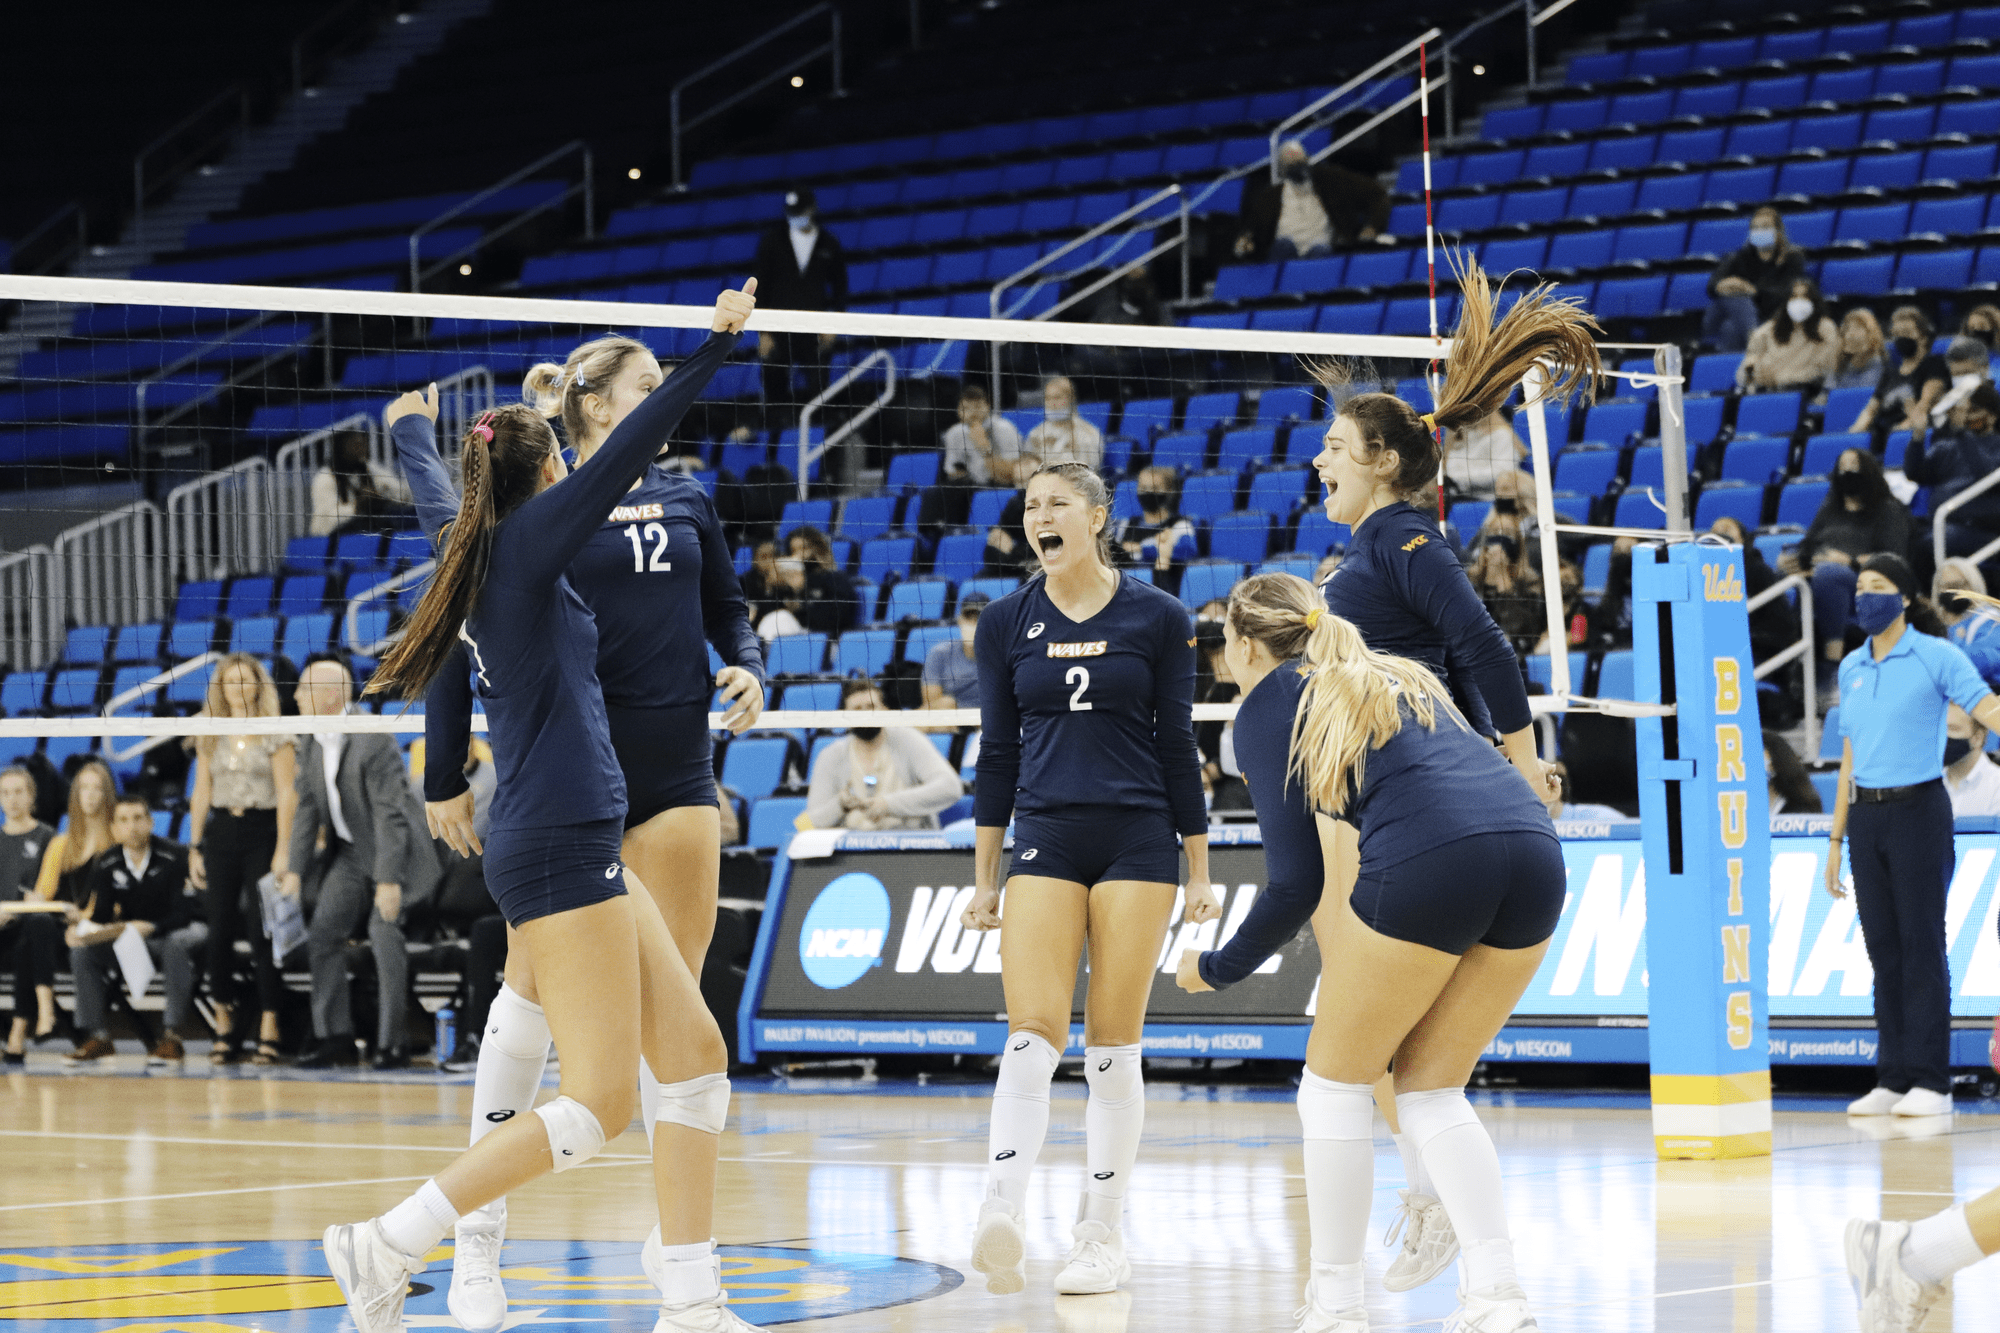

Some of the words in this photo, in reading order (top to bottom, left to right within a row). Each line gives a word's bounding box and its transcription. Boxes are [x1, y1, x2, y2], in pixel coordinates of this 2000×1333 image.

[624, 522, 671, 572] 12
[1047, 641, 1107, 658] WAVES
[1065, 666, 1092, 711] 2
[1713, 656, 1753, 1050] BRUINS
[805, 928, 883, 957] NCAA
[763, 1027, 803, 1042] PAULEY
[805, 1027, 856, 1043] PAVILION
[858, 1029, 910, 1046] presented
[912, 1029, 926, 1047] by
[927, 1029, 977, 1045] WESCOM
[1141, 1033, 1192, 1049] resented
[1195, 1033, 1210, 1052] by
[1497, 1039, 1514, 1059] by
[1515, 1040, 1572, 1057] WESCOM
[1789, 1038, 1857, 1059] presented
